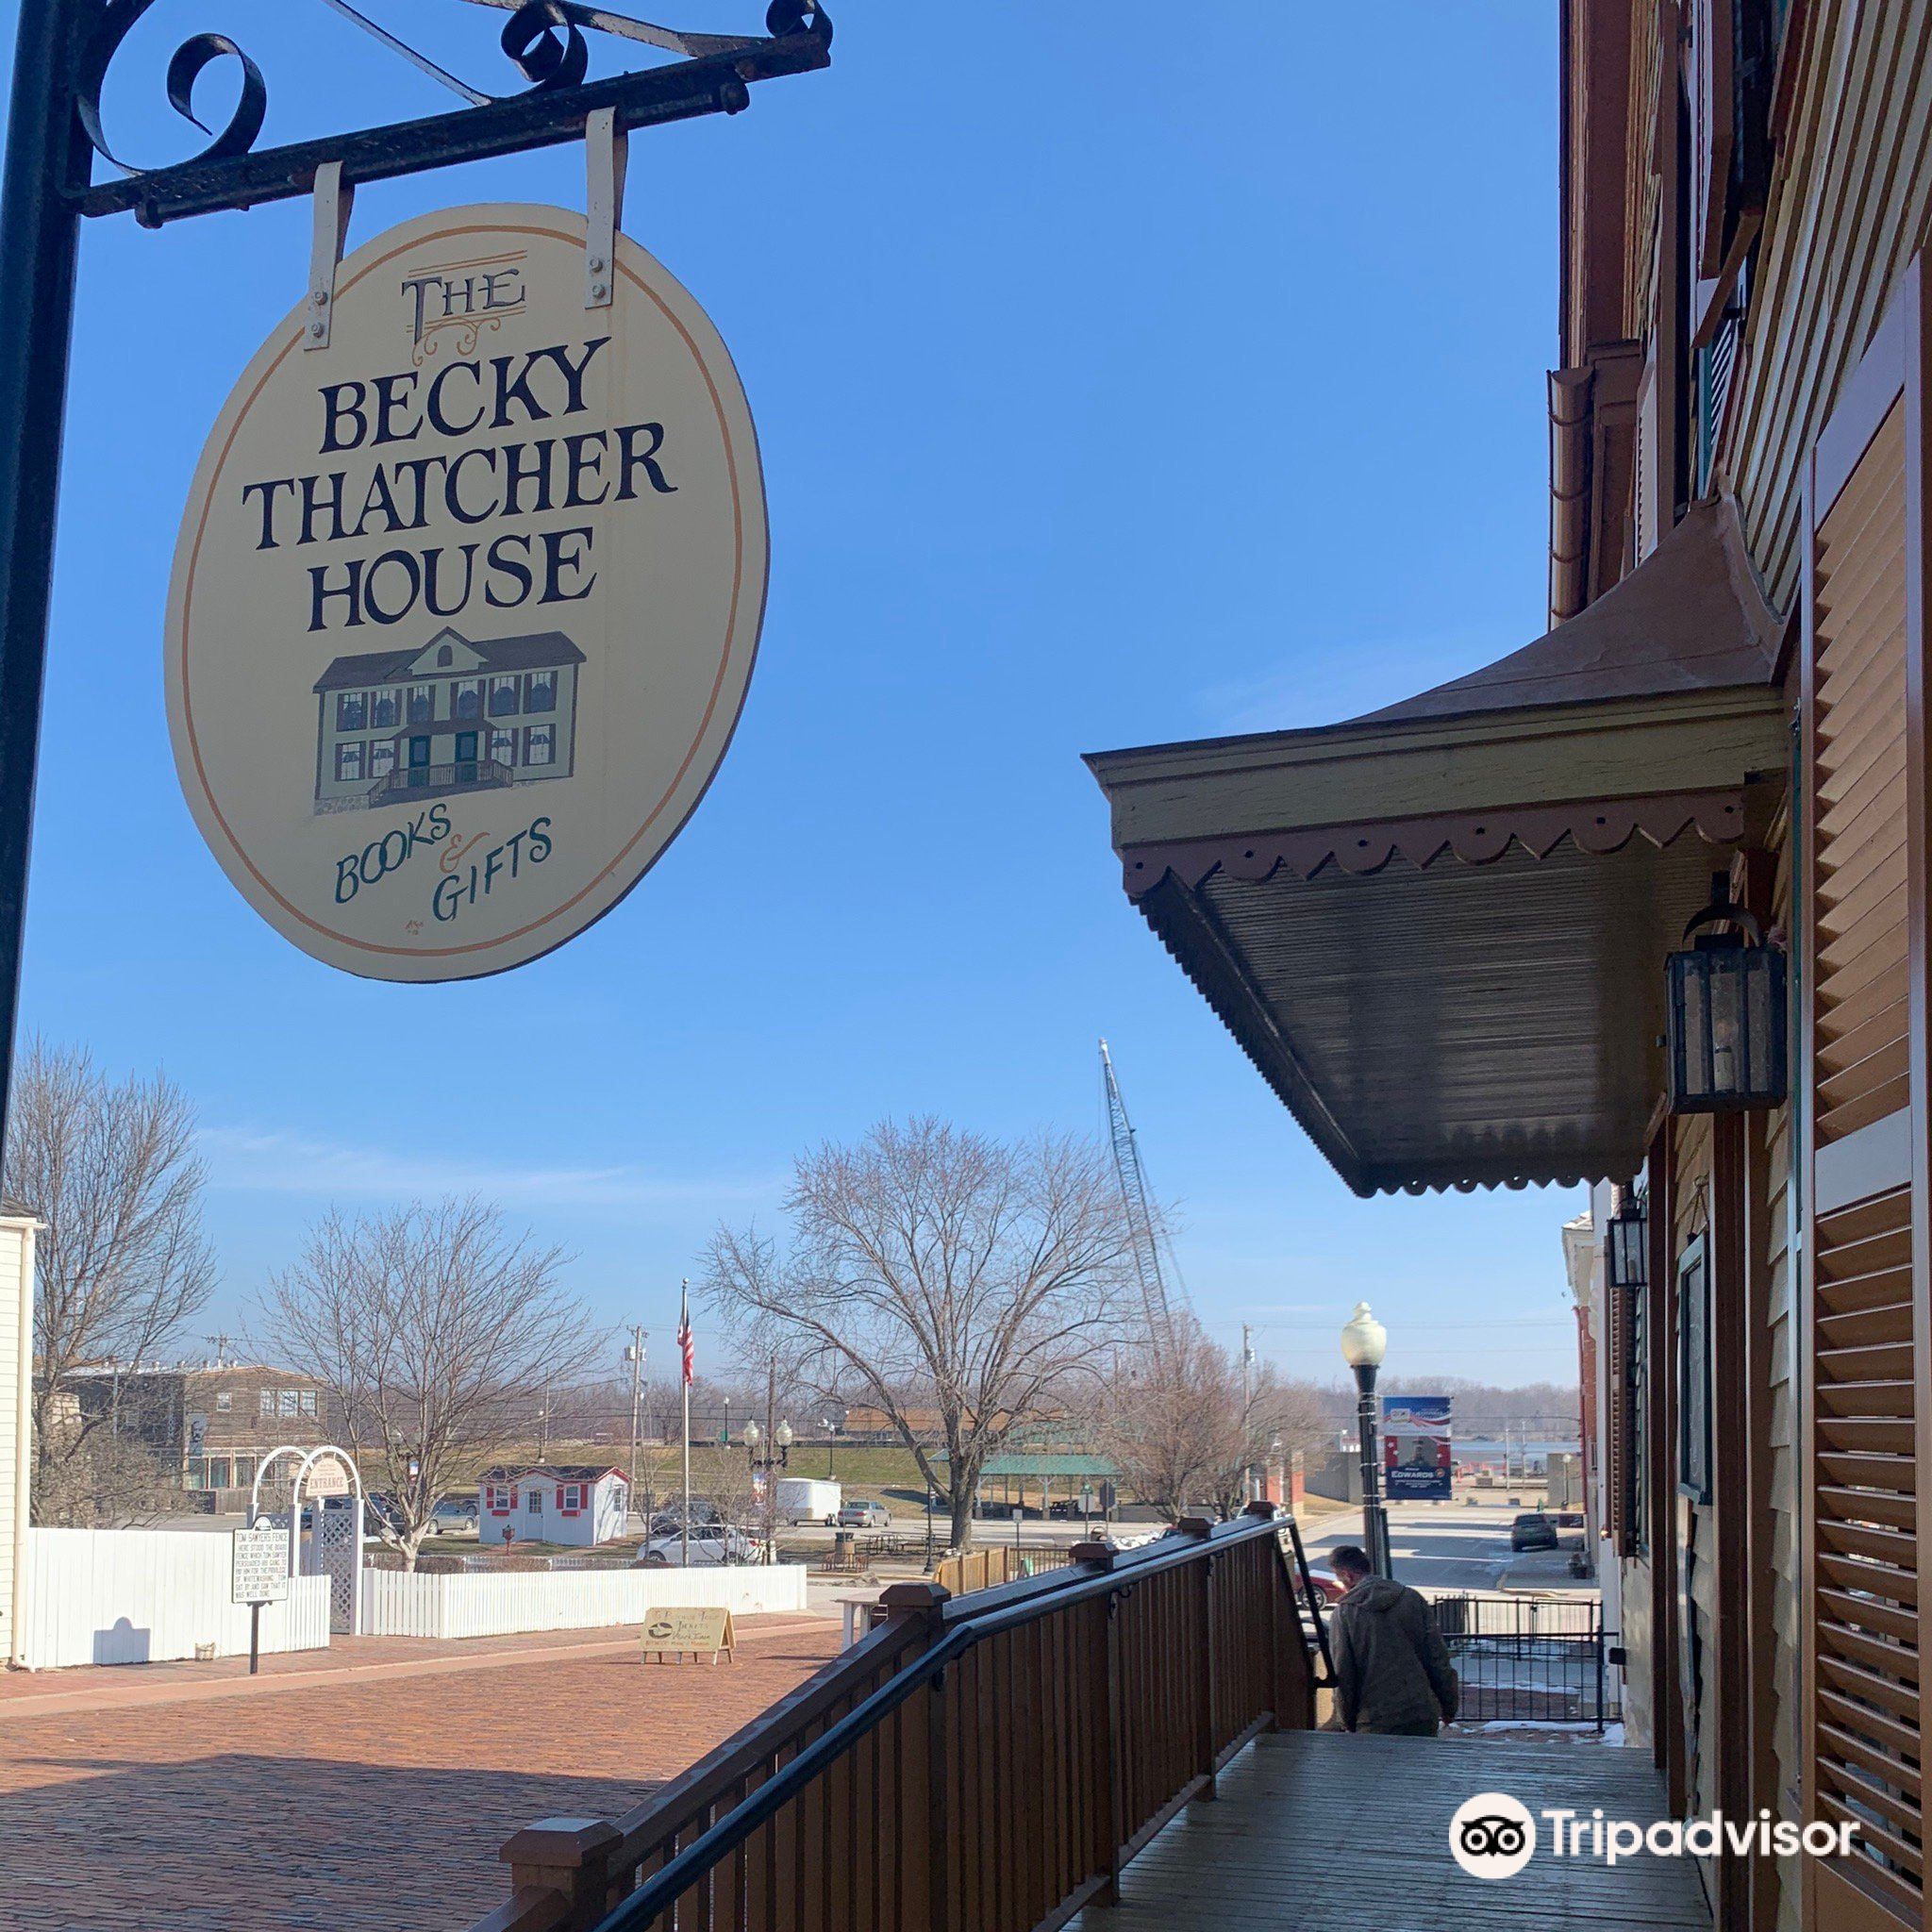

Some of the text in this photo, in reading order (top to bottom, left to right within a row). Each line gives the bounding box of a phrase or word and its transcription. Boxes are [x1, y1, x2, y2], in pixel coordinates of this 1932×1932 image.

[401, 269, 525, 344] THE
[318, 337, 611, 454] BECKY
[242, 422, 678, 550] THATCHER
[308, 526, 598, 632] HOUSE
[335, 803, 490, 904] BOOKS &
[433, 817, 552, 922] GIFTS
[310, 1476, 343, 1489] ENTRANCE
[236, 1533, 246, 1541] TOM
[273, 1533, 287, 1541] FENCE
